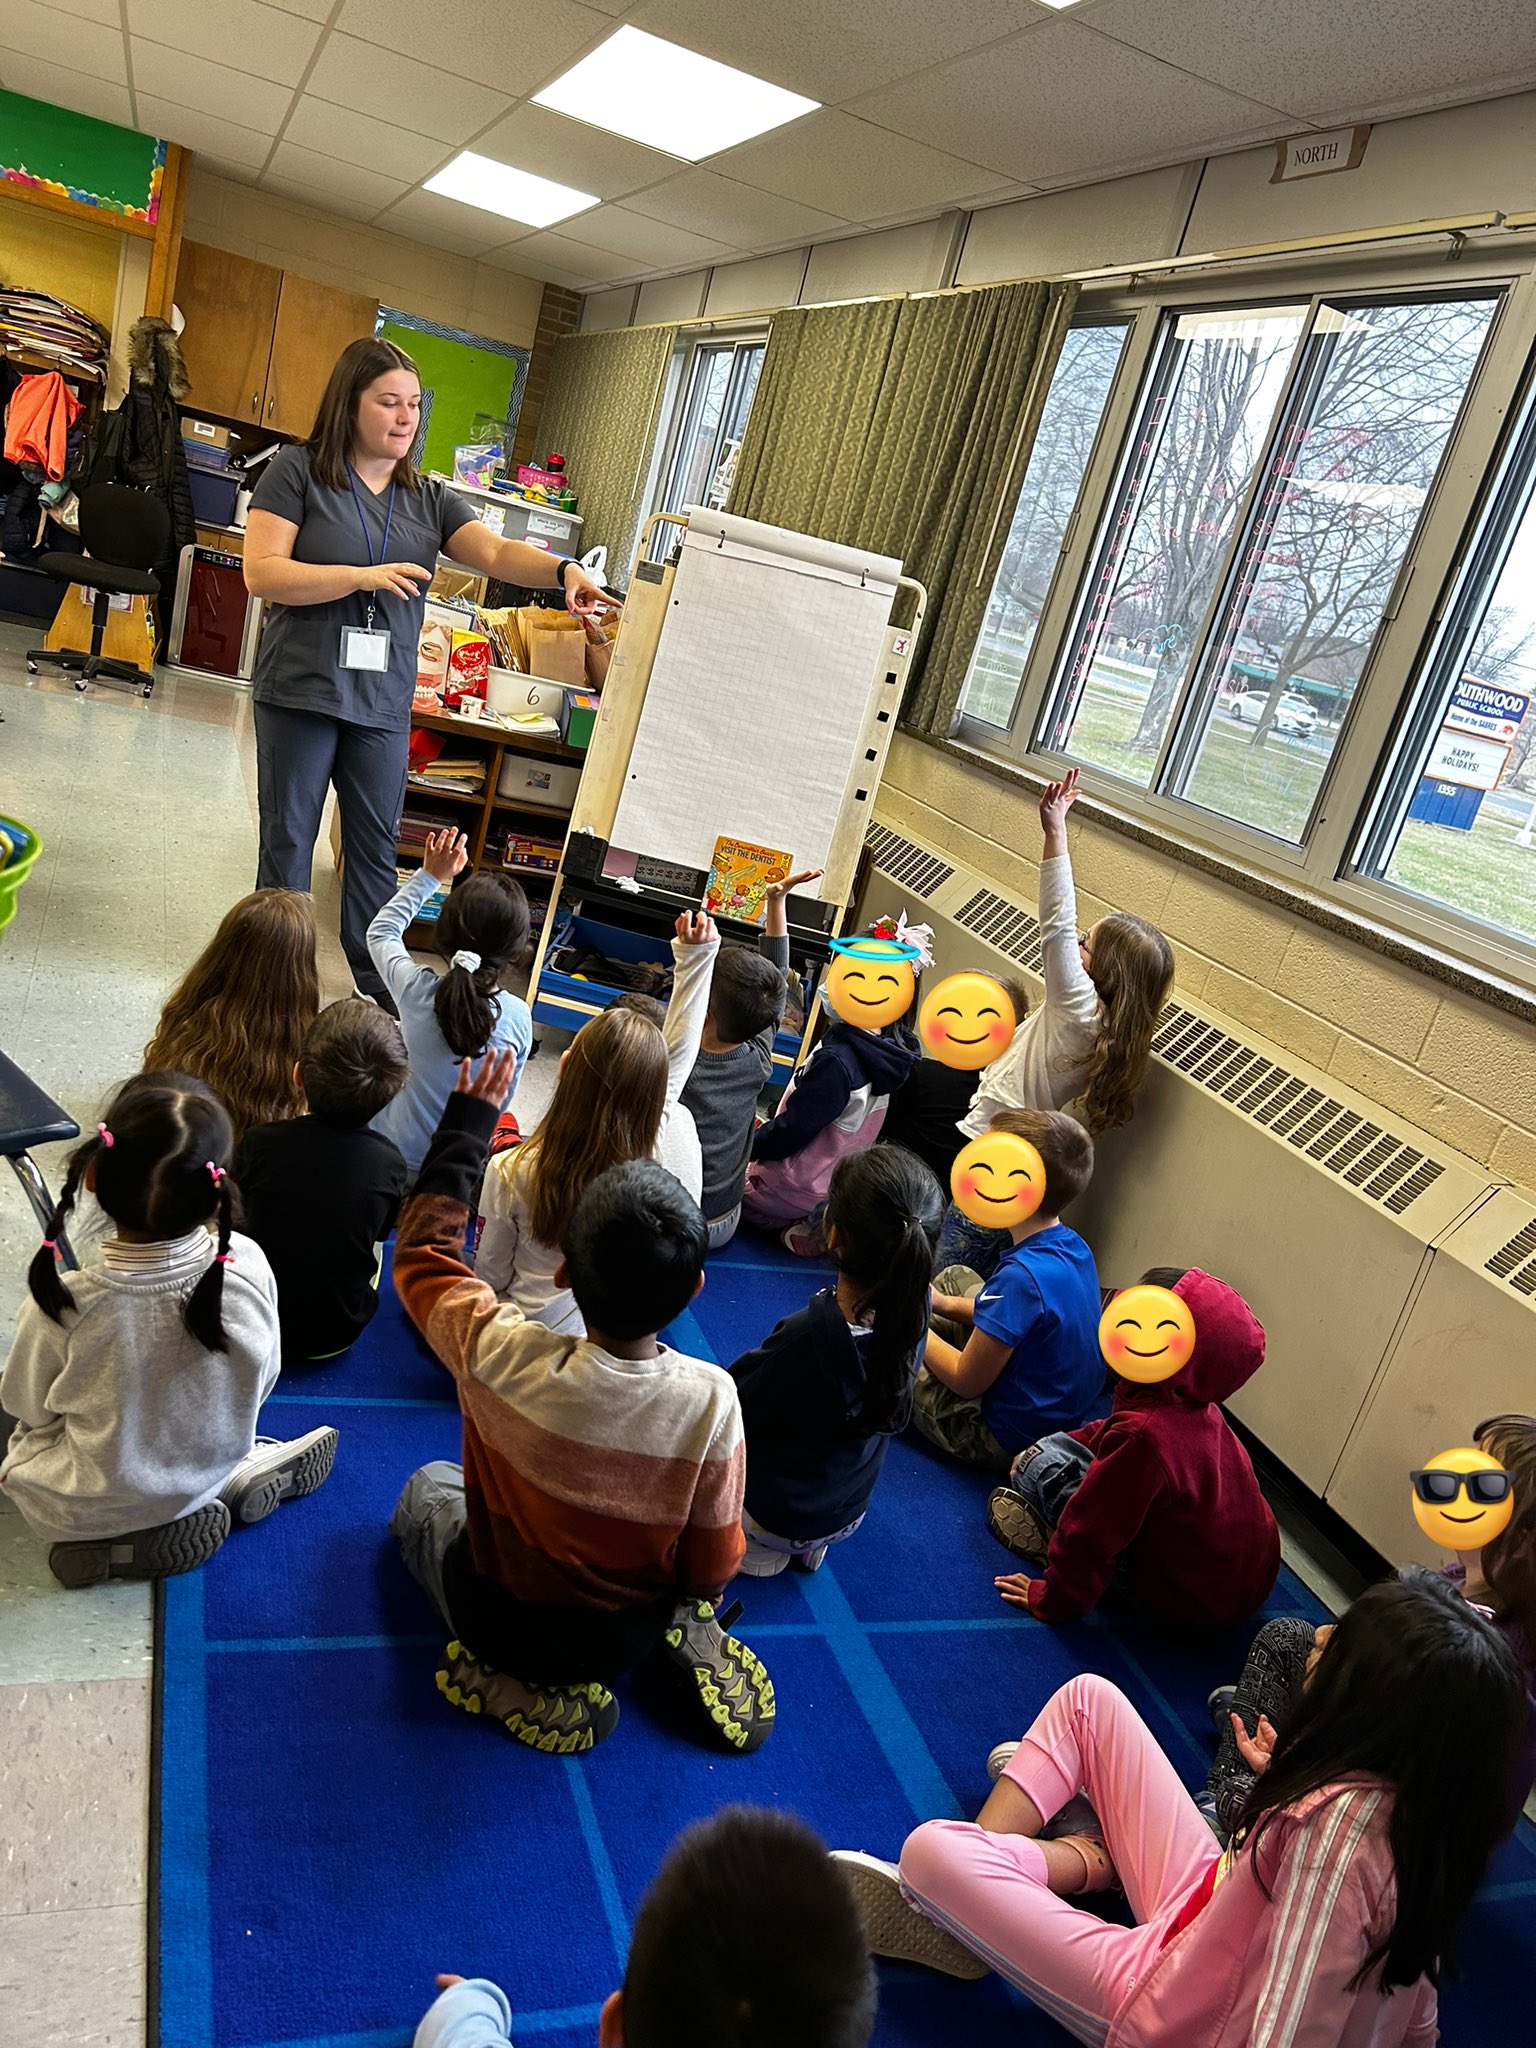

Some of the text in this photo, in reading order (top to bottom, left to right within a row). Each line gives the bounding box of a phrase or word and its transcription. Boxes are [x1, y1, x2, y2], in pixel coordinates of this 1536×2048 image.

[1294, 142, 1339, 167] NORTH
[526, 685, 540, 706] 6
[1455, 681, 1525, 713] OUTHWOOD
[1456, 697, 1504, 717] PUBLIC SCHOOL
[1450, 712, 1498, 731] Home of the SABRES
[1441, 755, 1480, 772] HOLIDAYS!
[1451, 747, 1475, 760] HAPPY
[721, 845, 737, 856] VISIT
[737, 848, 750, 860] THE
[750, 852, 776, 866] DENTIST
